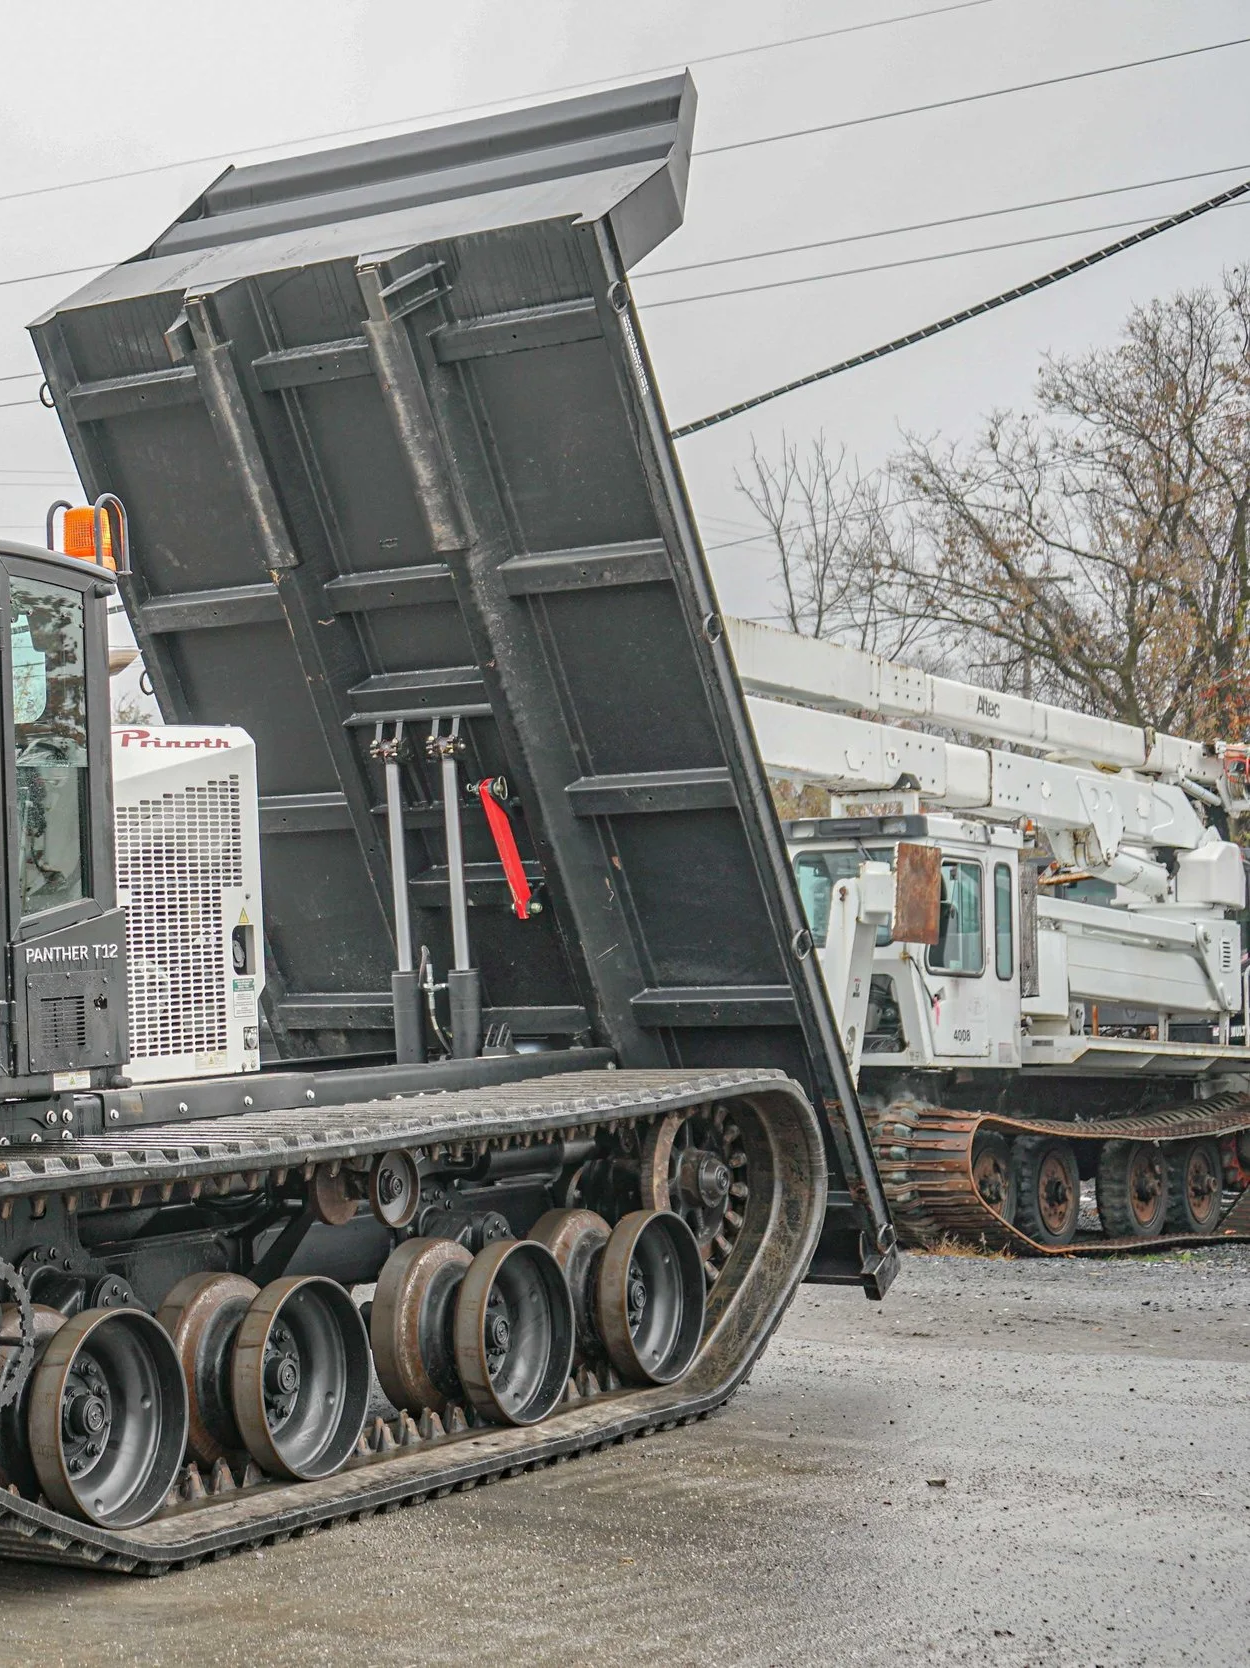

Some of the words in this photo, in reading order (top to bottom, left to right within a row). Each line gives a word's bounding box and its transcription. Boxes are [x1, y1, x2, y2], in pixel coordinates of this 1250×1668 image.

[628, 335, 639, 367] CAPACITY
[976, 695, 1000, 718] Altec
[111, 730, 231, 748] Prinoth
[26, 946, 89, 963] PANTHER
[92, 944, 118, 960] T12
[953, 1029, 971, 1041] 4008
